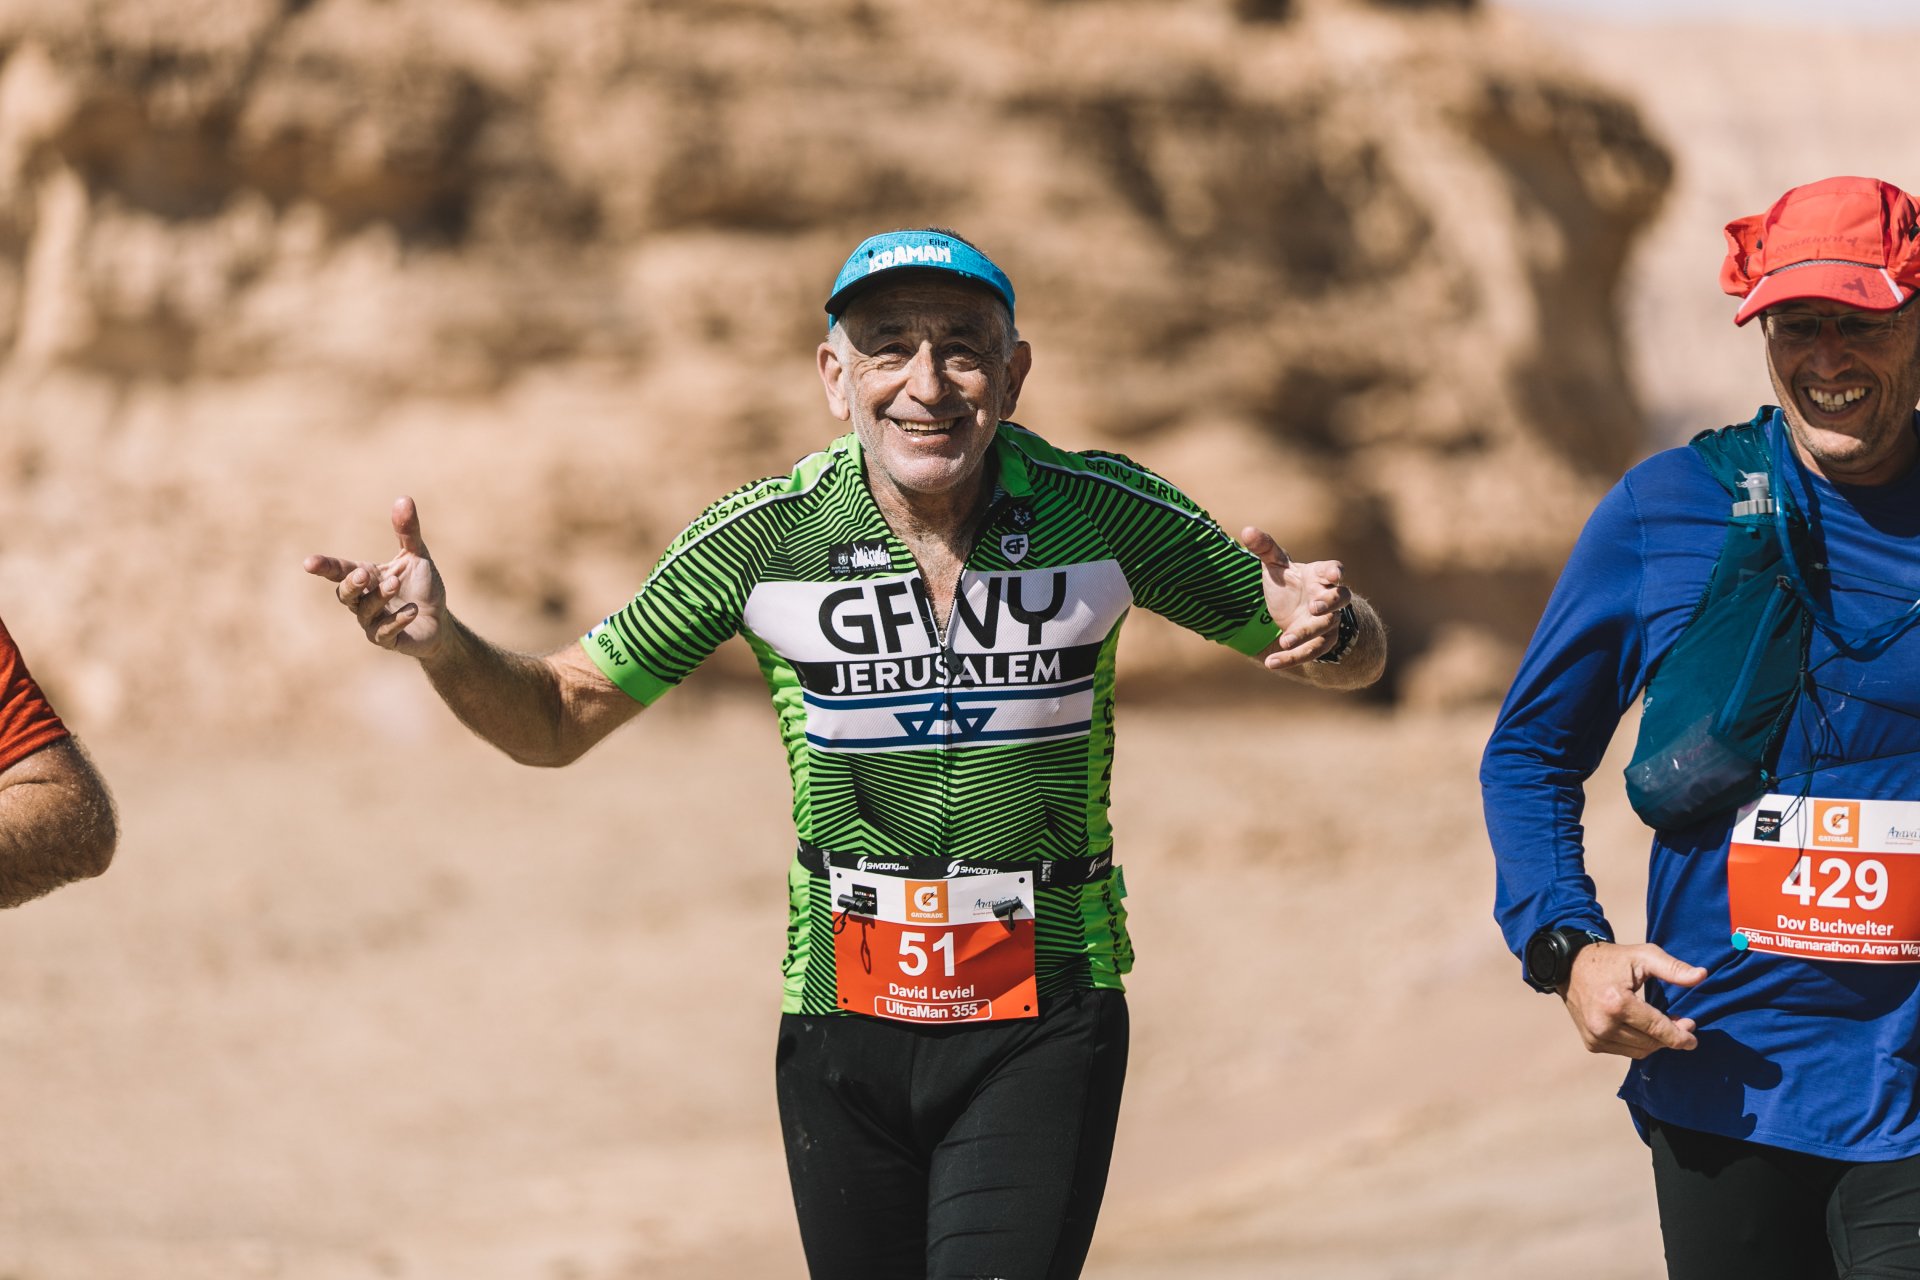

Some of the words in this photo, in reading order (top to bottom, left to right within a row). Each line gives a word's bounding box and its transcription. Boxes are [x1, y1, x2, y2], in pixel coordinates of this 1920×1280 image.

[1084, 459, 1132, 482] GFNY
[680, 483, 785, 546] JERUSALEM
[818, 571, 1067, 656] GFNY
[598, 633, 628, 667] GFNY
[831, 650, 1062, 696] JERUSALEM
[1781, 855, 1889, 911] 429
[1777, 914, 1807, 931] Dov
[1809, 917, 1894, 936] Buchvelter
[898, 931, 955, 976] 51
[1775, 935, 1860, 954] Ultramarathon
[1861, 942, 1899, 956] Arava
[889, 982, 928, 999] David
[932, 984, 975, 1000] Leviel
[886, 1000, 949, 1018] UltraMan
[952, 1003, 978, 1018] 355
